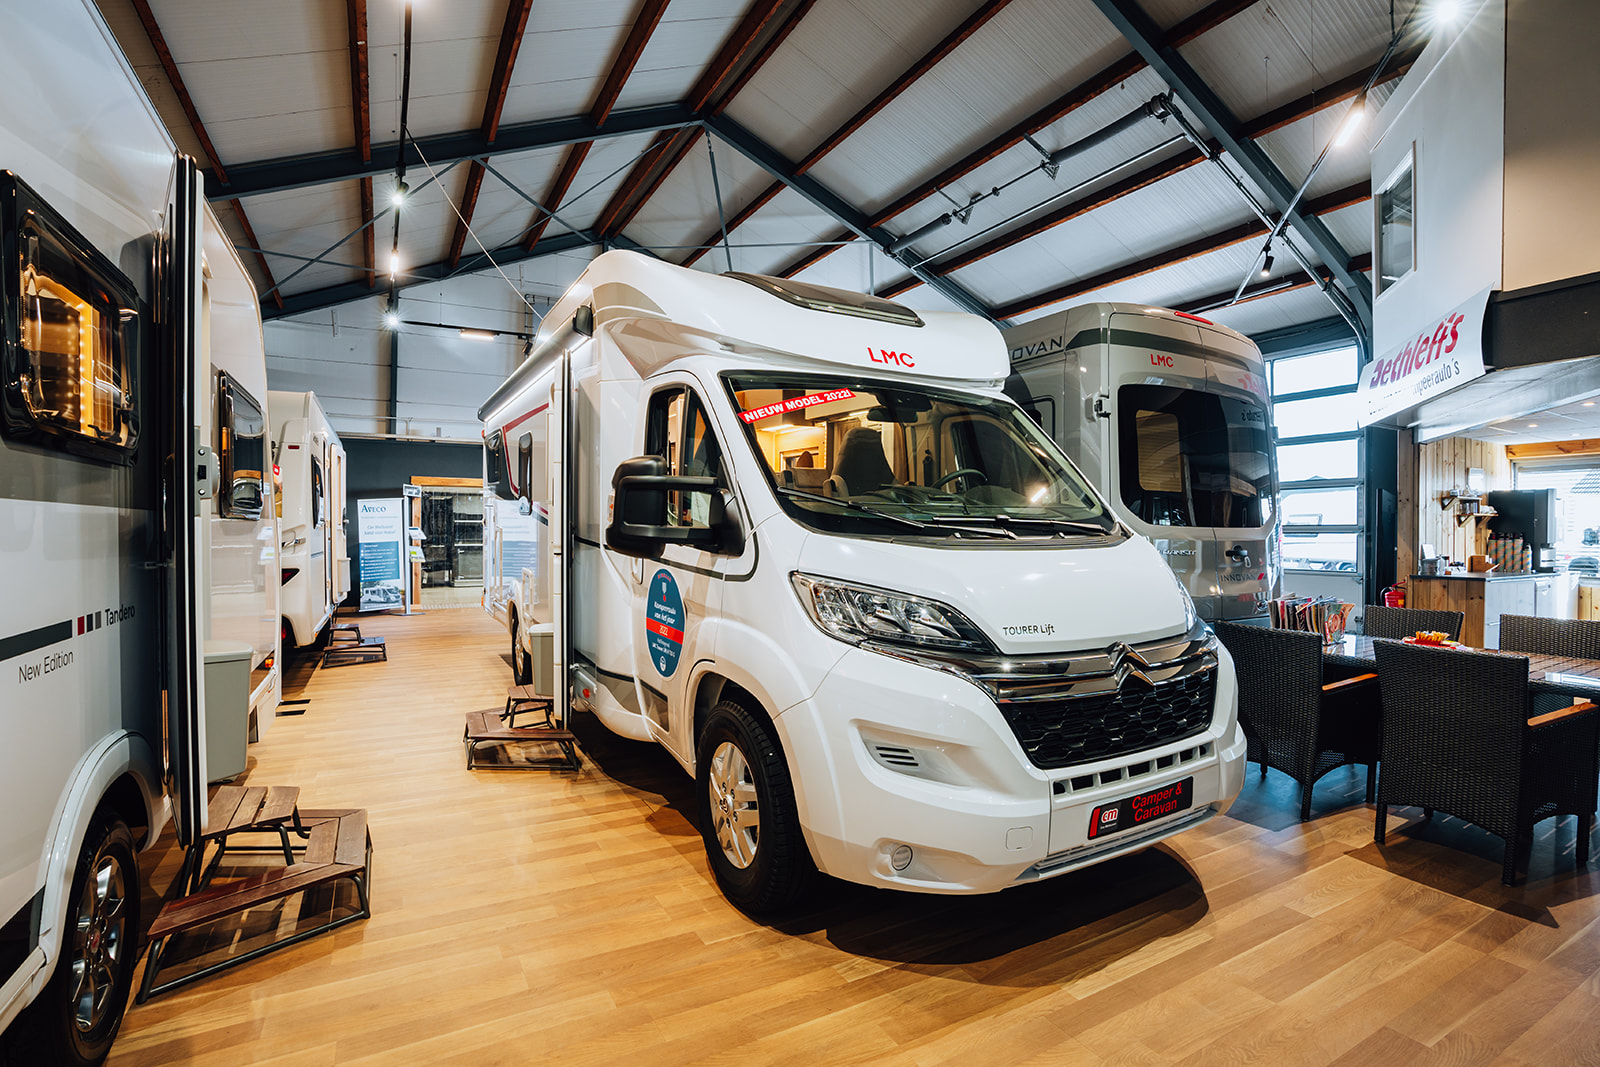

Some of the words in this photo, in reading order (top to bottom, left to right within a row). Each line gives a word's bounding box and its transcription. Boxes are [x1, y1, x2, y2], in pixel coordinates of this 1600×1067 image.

[867, 347, 915, 368] LMC
[1012, 336, 1063, 361] OVAN
[1150, 353, 1174, 368] LMC
[744, 403, 785, 422] NIEUW
[786, 395, 825, 409] MODEL
[1220, 573, 1256, 582] INNOVAN
[105, 604, 136, 626] Tandero
[1003, 625, 1039, 636] TOURER
[1040, 623, 1055, 636] Lift
[18, 662, 41, 684] New
[44, 651, 74, 674] Edition
[1132, 786, 1173, 809] Camper
[1175, 782, 1183, 795] &
[1134, 799, 1178, 822] Caravan
